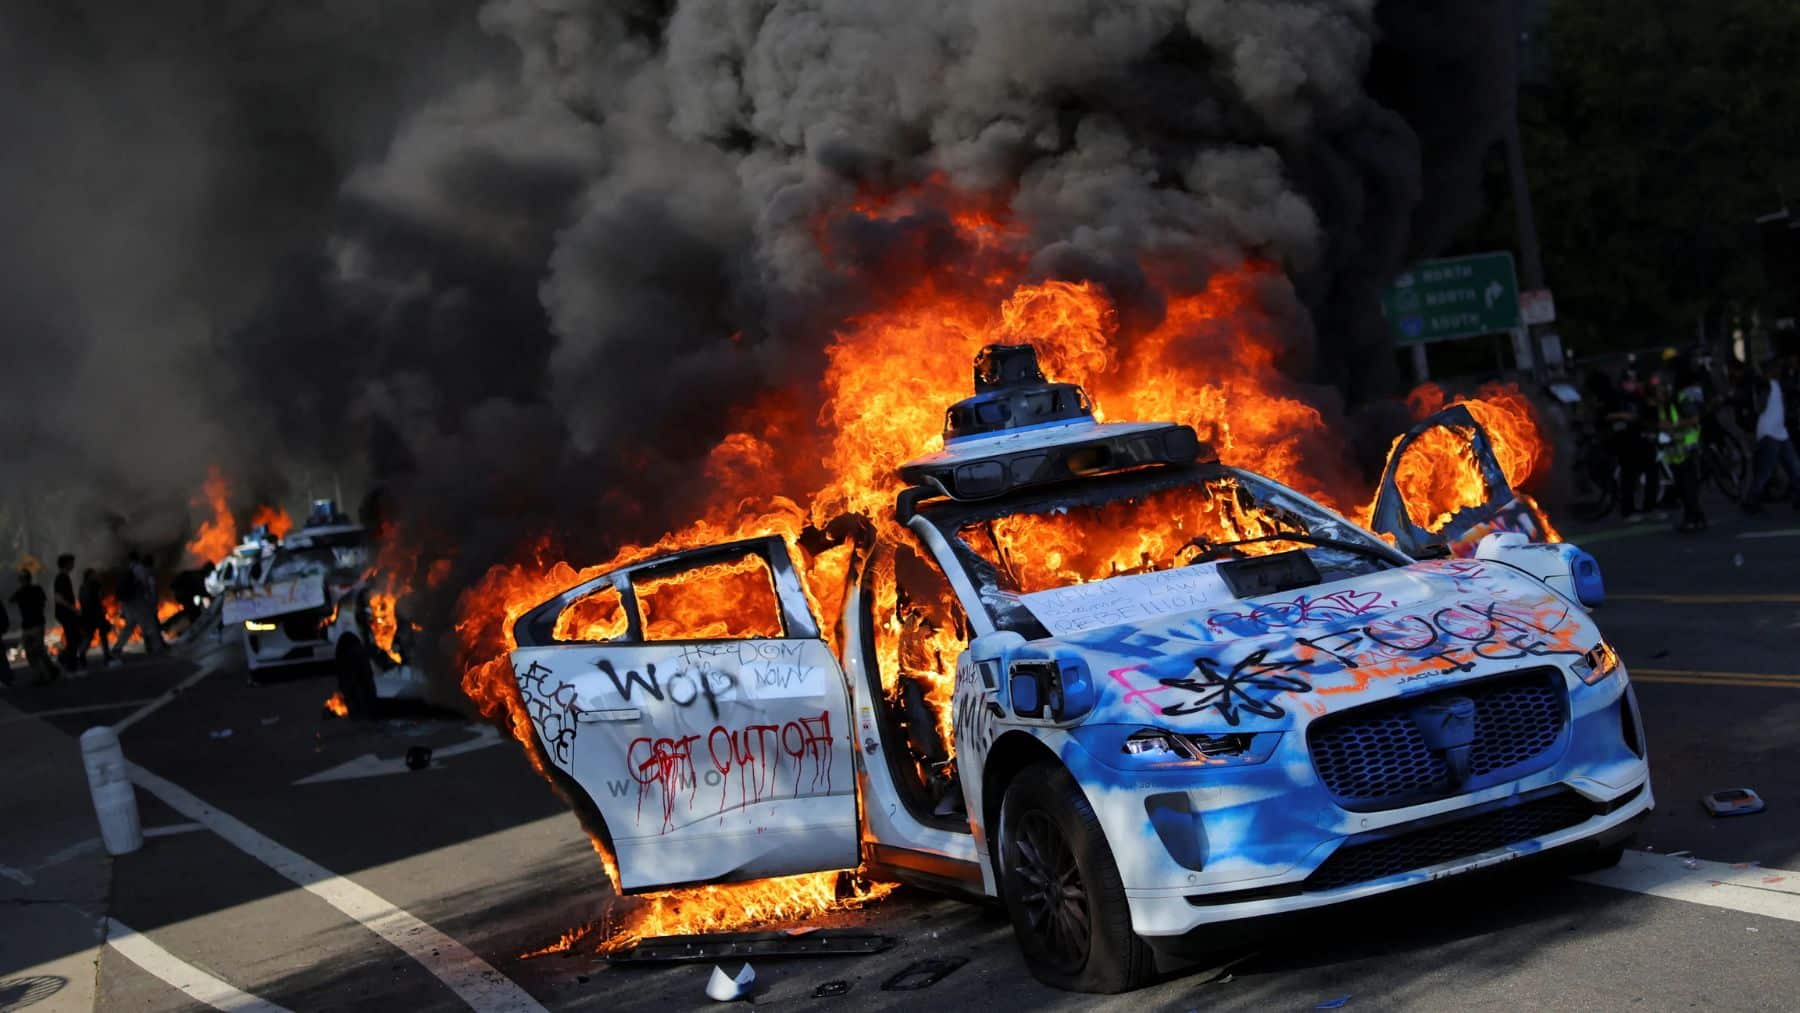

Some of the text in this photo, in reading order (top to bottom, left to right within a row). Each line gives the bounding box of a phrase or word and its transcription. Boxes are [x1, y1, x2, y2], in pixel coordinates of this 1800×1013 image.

[1295, 602, 1560, 668] FUCK
[1421, 635, 1583, 677] ICE
[628, 735, 700, 784] GET
[708, 725, 779, 775] OUT
